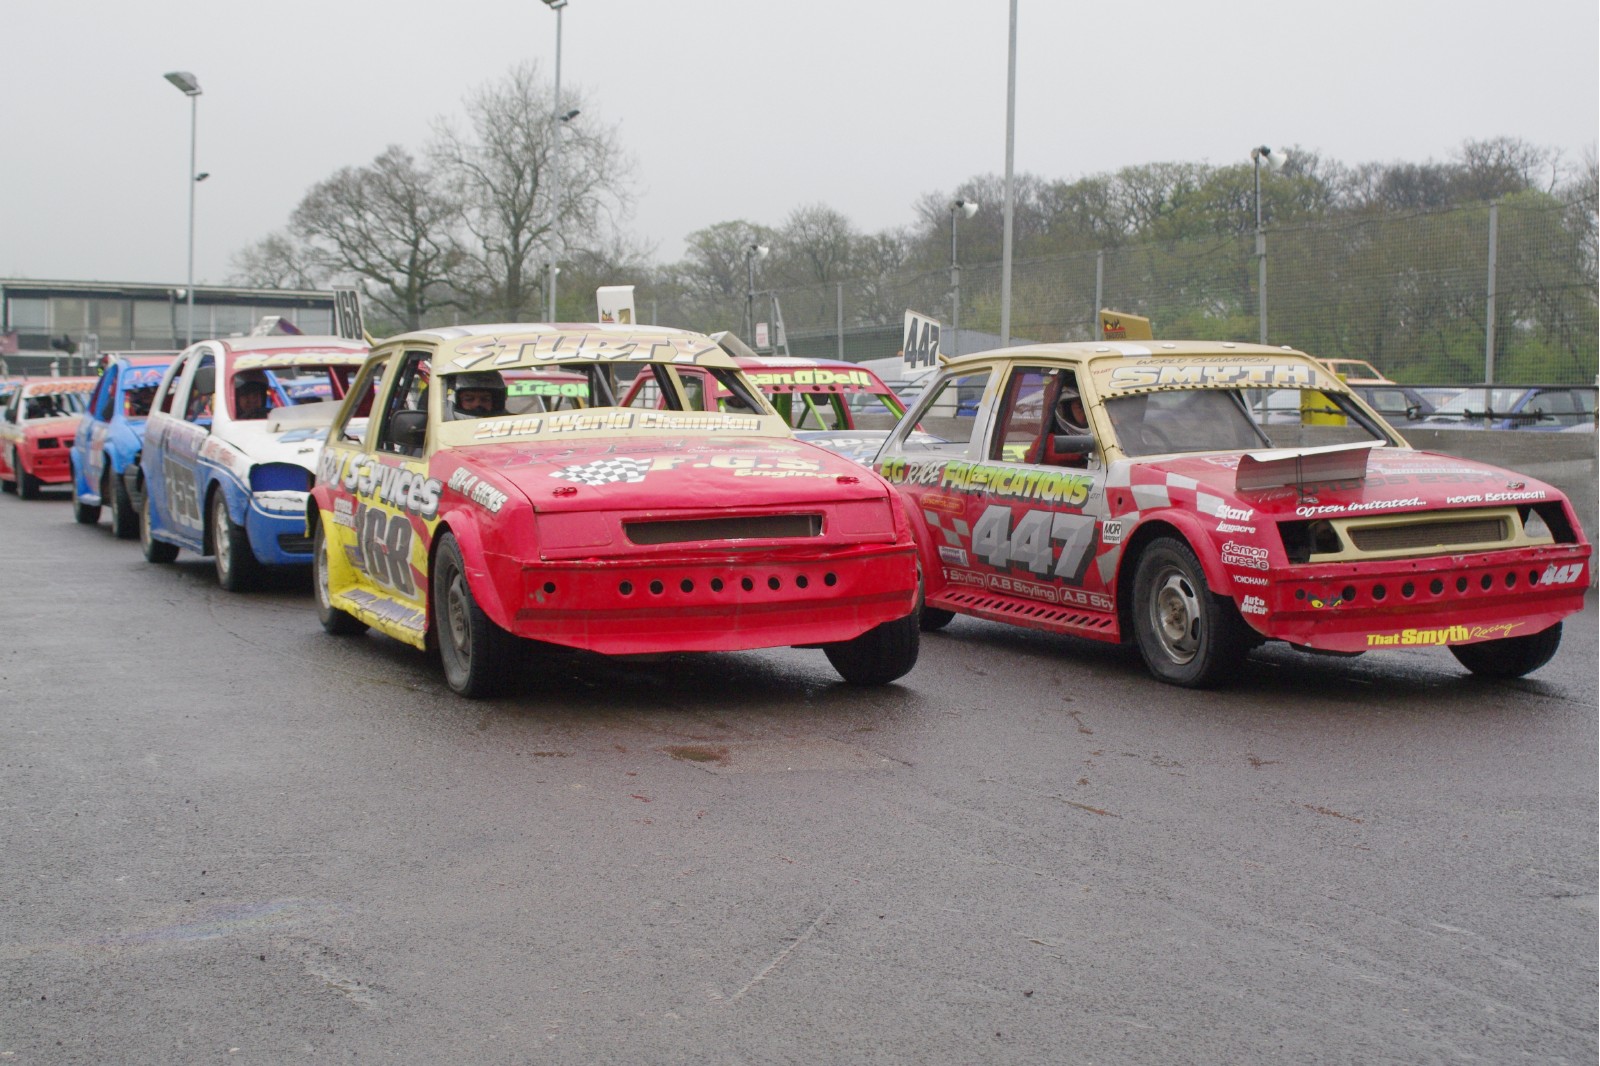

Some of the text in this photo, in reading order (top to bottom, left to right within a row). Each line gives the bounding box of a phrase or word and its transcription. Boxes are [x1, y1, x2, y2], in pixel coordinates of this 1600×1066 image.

[335, 289, 364, 340] 168
[451, 332, 718, 369] STURTY
[904, 317, 940, 369] 447
[1109, 364, 1315, 389] SMYTH
[474, 412, 762, 440] 2010 World Champion
[649, 455, 826, 471] F.G.S
[907, 459, 948, 485] RACE
[344, 453, 444, 521] Services
[1296, 502, 1346, 517] Often
[1104, 523, 1121, 535] MOR
[355, 502, 417, 598] 168
[972, 504, 1098, 582] 447
[1222, 540, 1269, 559] demon
[950, 570, 986, 587] Styling
[1540, 563, 1584, 586] 447
[989, 576, 1055, 600] A.B Styling
[1063, 590, 1088, 605] A.B
[1243, 594, 1265, 606] Auto
[1241, 602, 1268, 615] Meter
[1366, 622, 1526, 646] That Smyth Racing
